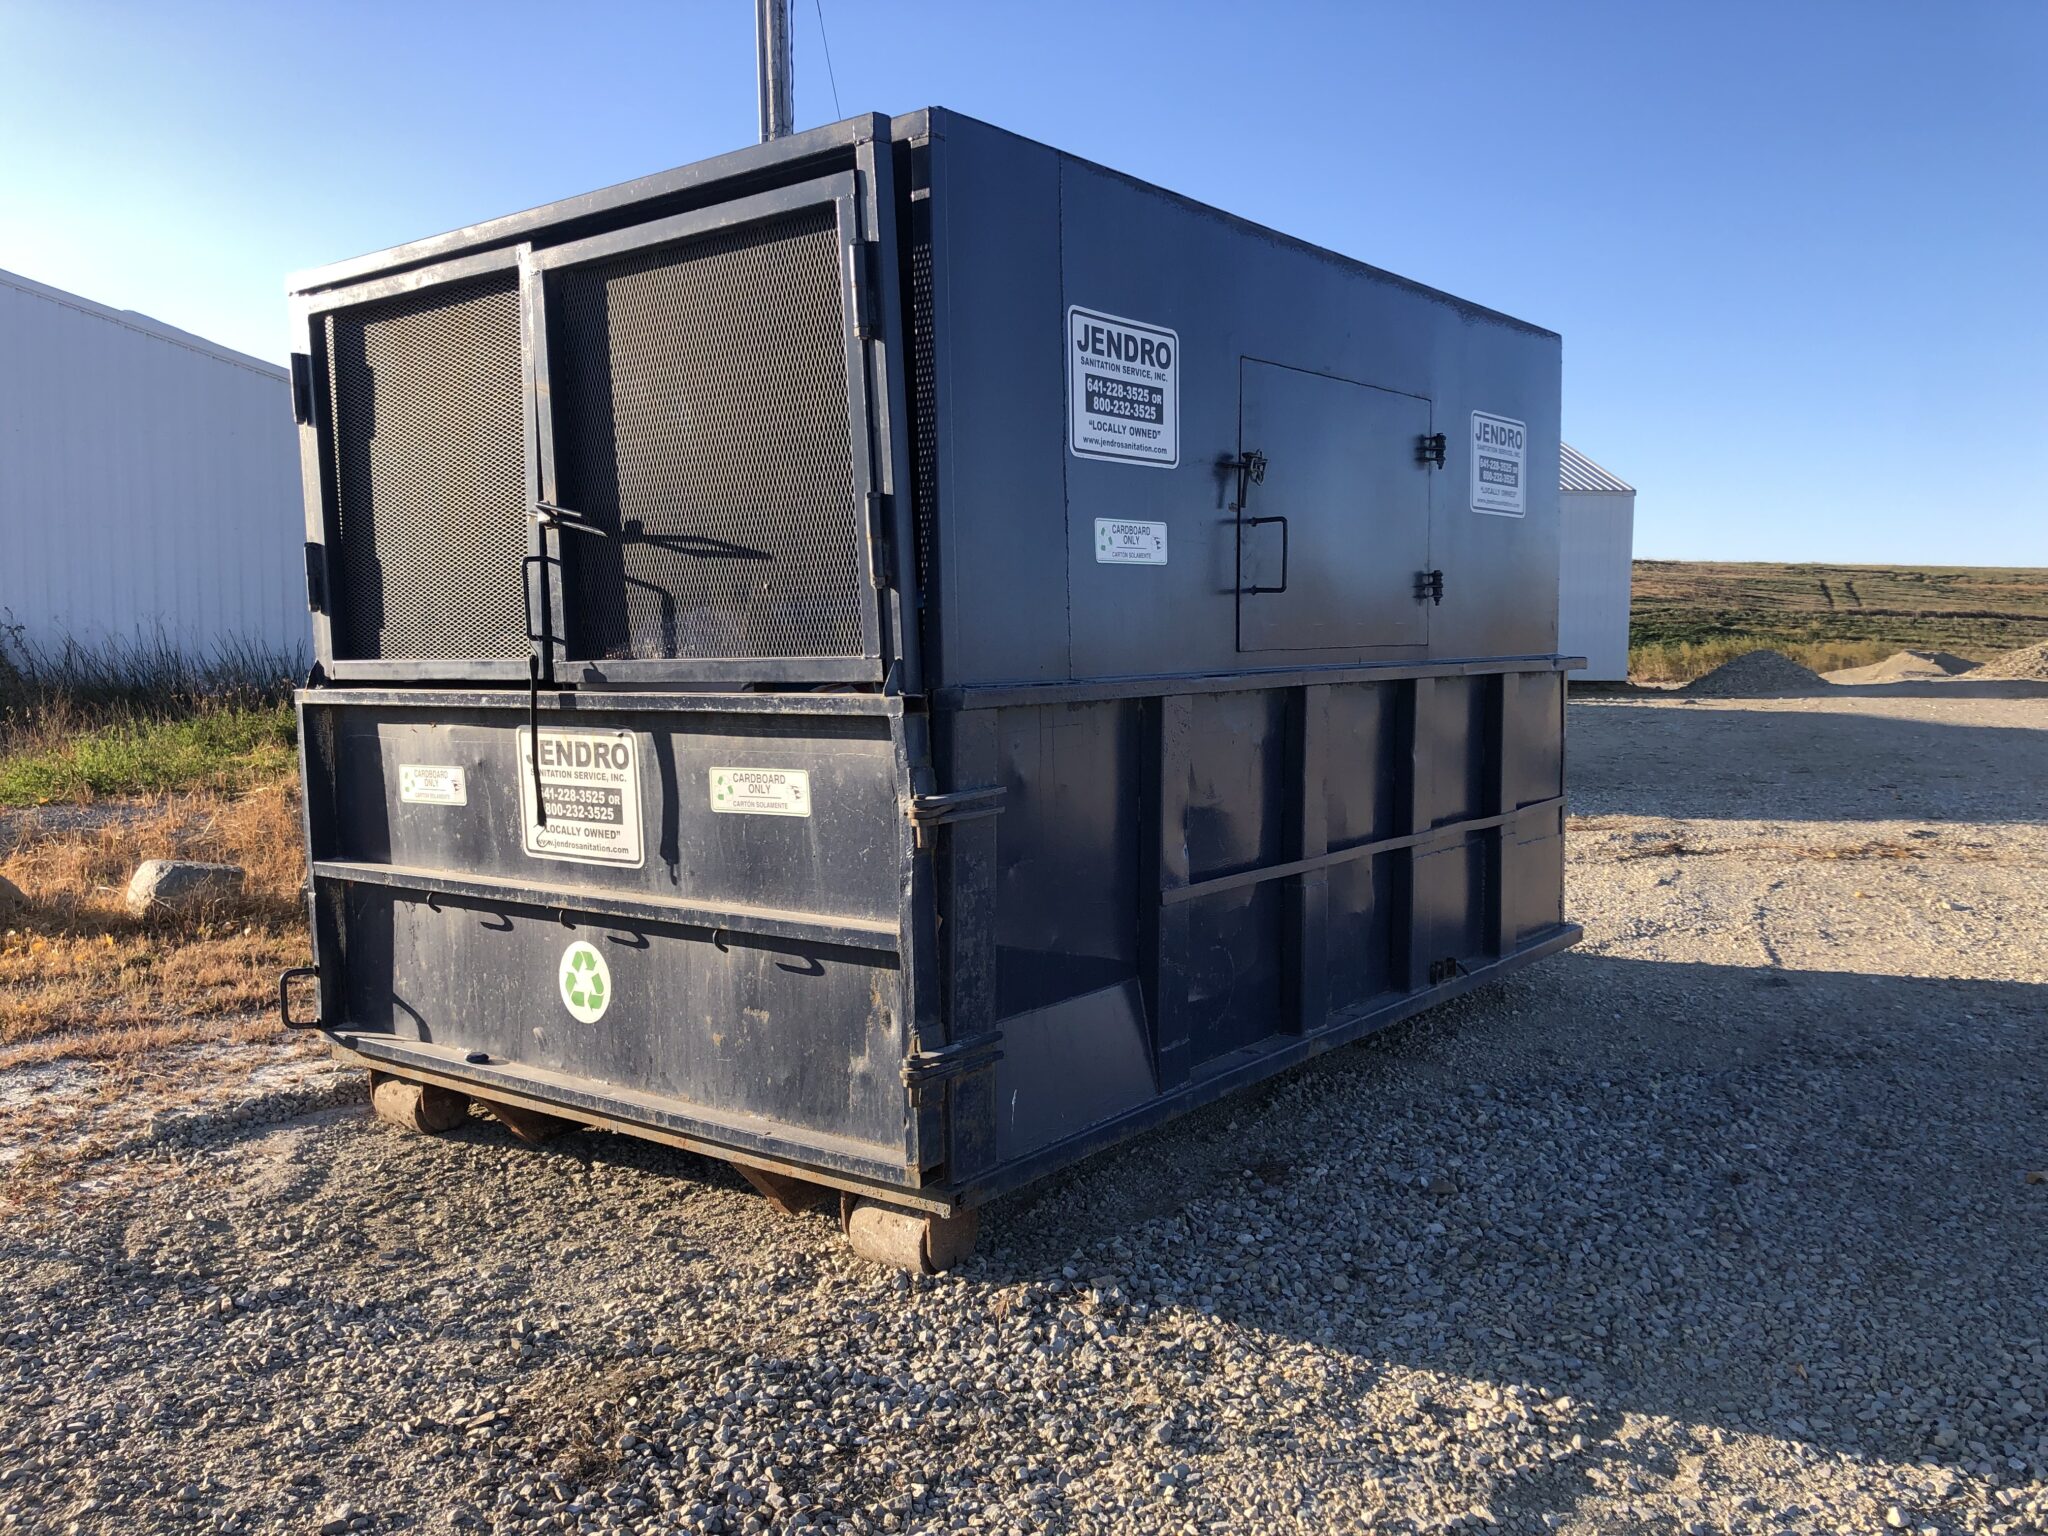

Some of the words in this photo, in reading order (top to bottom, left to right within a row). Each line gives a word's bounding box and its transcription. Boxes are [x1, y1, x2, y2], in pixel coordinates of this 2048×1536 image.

[1077, 324, 1171, 369] JENDRO
[1081, 356, 1120, 373] SANITATION
[1122, 365, 1153, 381] SERVICE,
[1154, 372, 1168, 382] INC.
[1087, 378, 1149, 402] 641-228-3525
[1151, 393, 1162, 405] OR
[1093, 396, 1156, 420] 800-232-3525
[1475, 422, 1522, 450] JENDRO
[1083, 436, 1167, 455] www.jendrosanitation.com
[1112, 524, 1150, 535] CARDBOARD
[1123, 535, 1140, 545] ONLY
[414, 769, 448, 779] CARDBOARD
[530, 768, 572, 779] SNITATION
[574, 771, 609, 782] SERVICE,
[611, 773, 627, 782] INC.
[733, 773, 785, 784] CARDBOARD
[424, 778, 438, 787] ONLY
[748, 783, 771, 794] ONLY
[541, 787, 605, 804] 41-228-3525
[608, 795, 620, 805] OR
[545, 803, 614, 820] 800-232-3525
[537, 839, 629, 854] www.jendrosanitation.com
